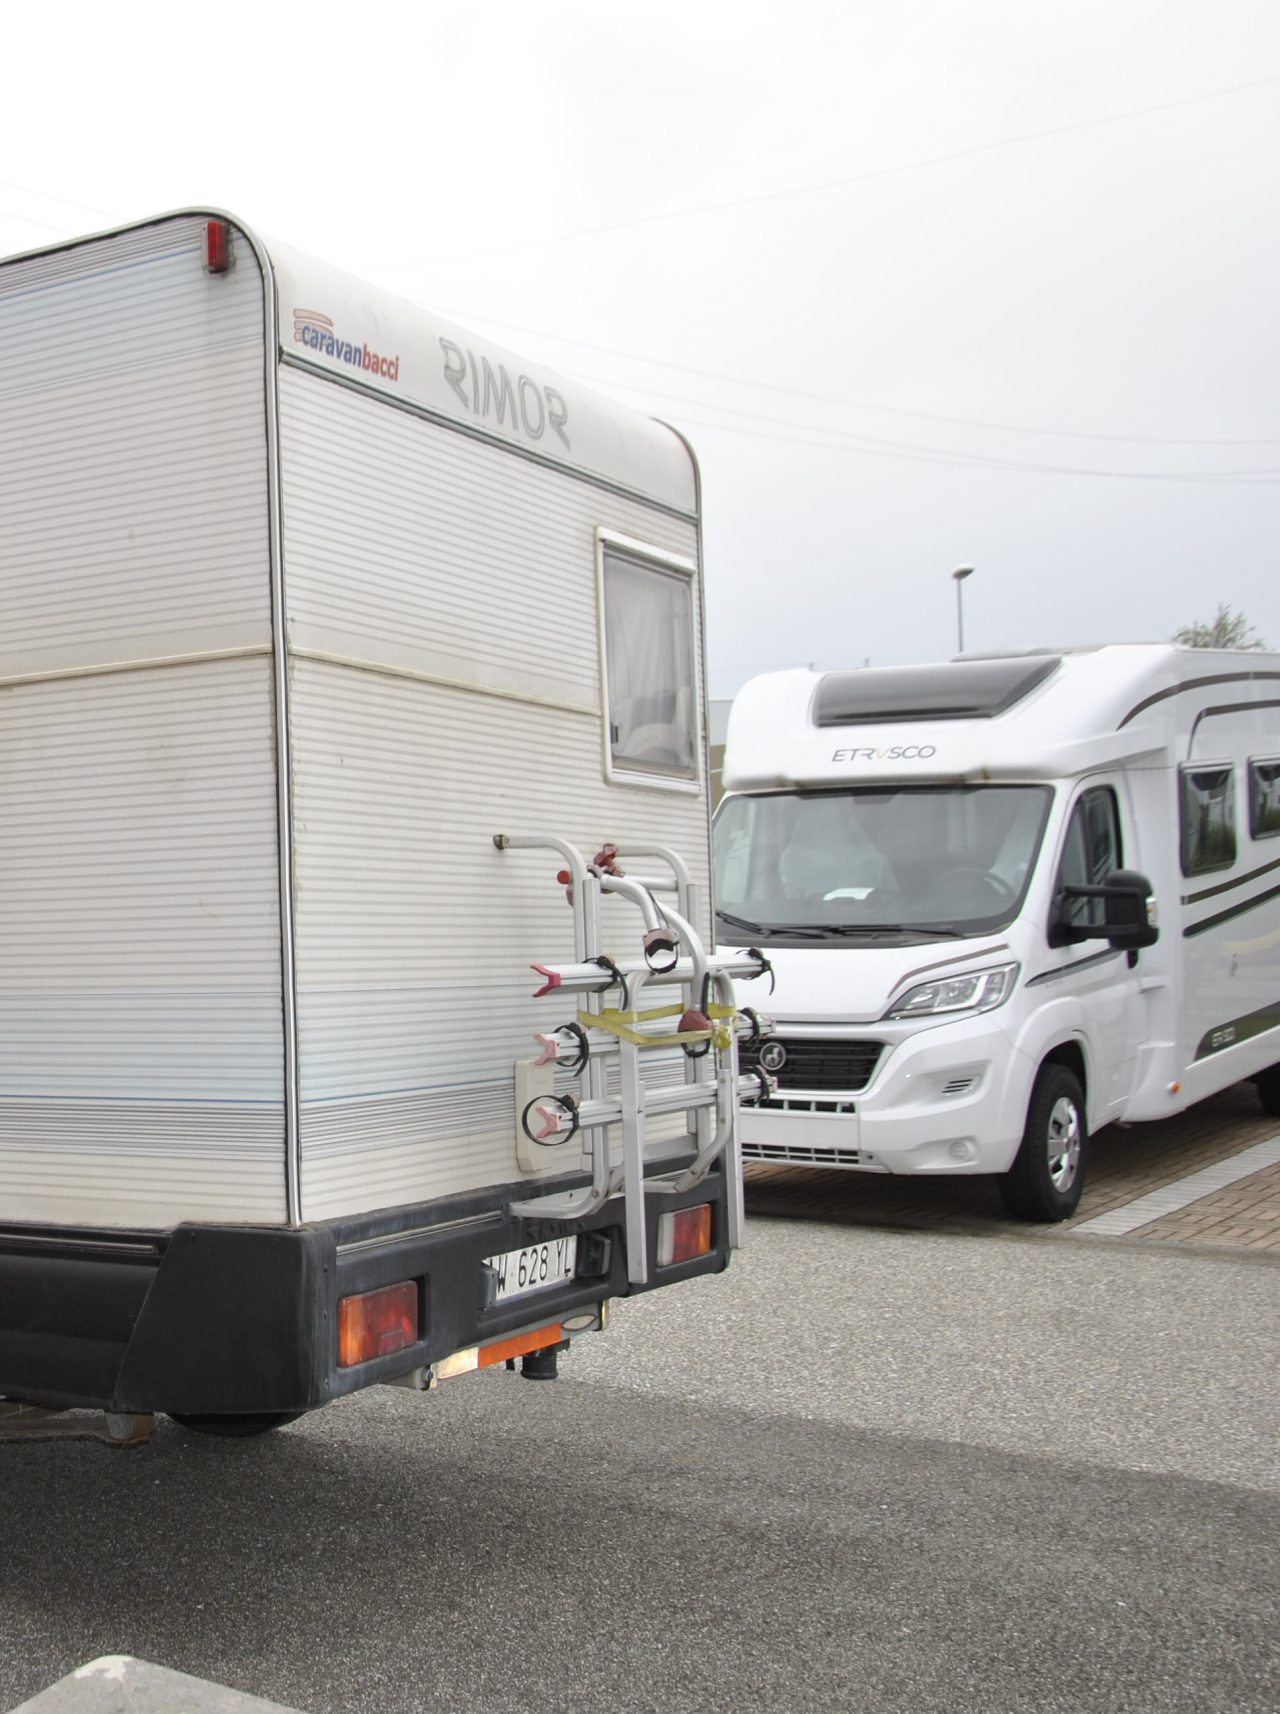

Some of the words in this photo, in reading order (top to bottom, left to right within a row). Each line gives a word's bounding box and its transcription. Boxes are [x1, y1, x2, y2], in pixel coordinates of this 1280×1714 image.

[302, 325, 399, 381] caravanbacci
[439, 337, 571, 450] RIMOR
[517, 1245, 549, 1288] 628
[555, 1237, 571, 1275] YL
